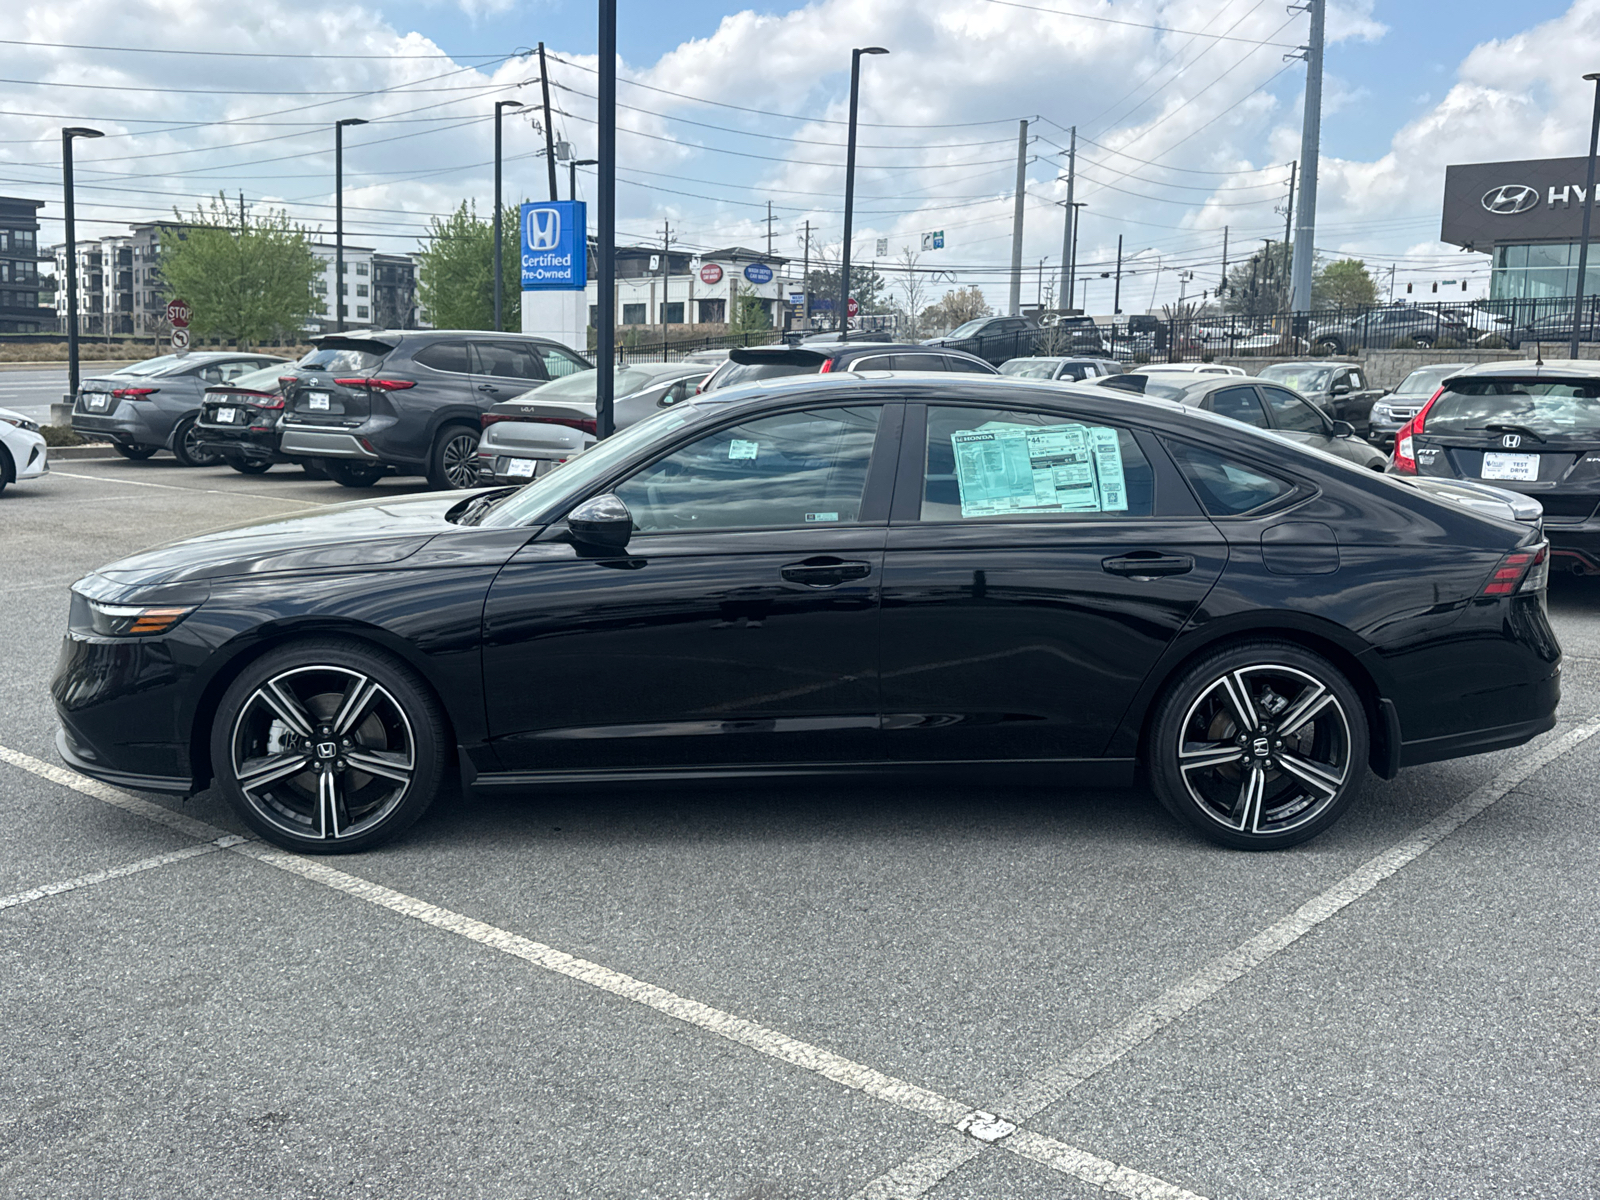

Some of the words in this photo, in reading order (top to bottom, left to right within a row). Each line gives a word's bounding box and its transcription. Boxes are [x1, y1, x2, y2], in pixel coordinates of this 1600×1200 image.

[521, 253, 571, 267] Certified
[522, 268, 571, 279] Pre-Owned
[169, 306, 193, 320] STOP
